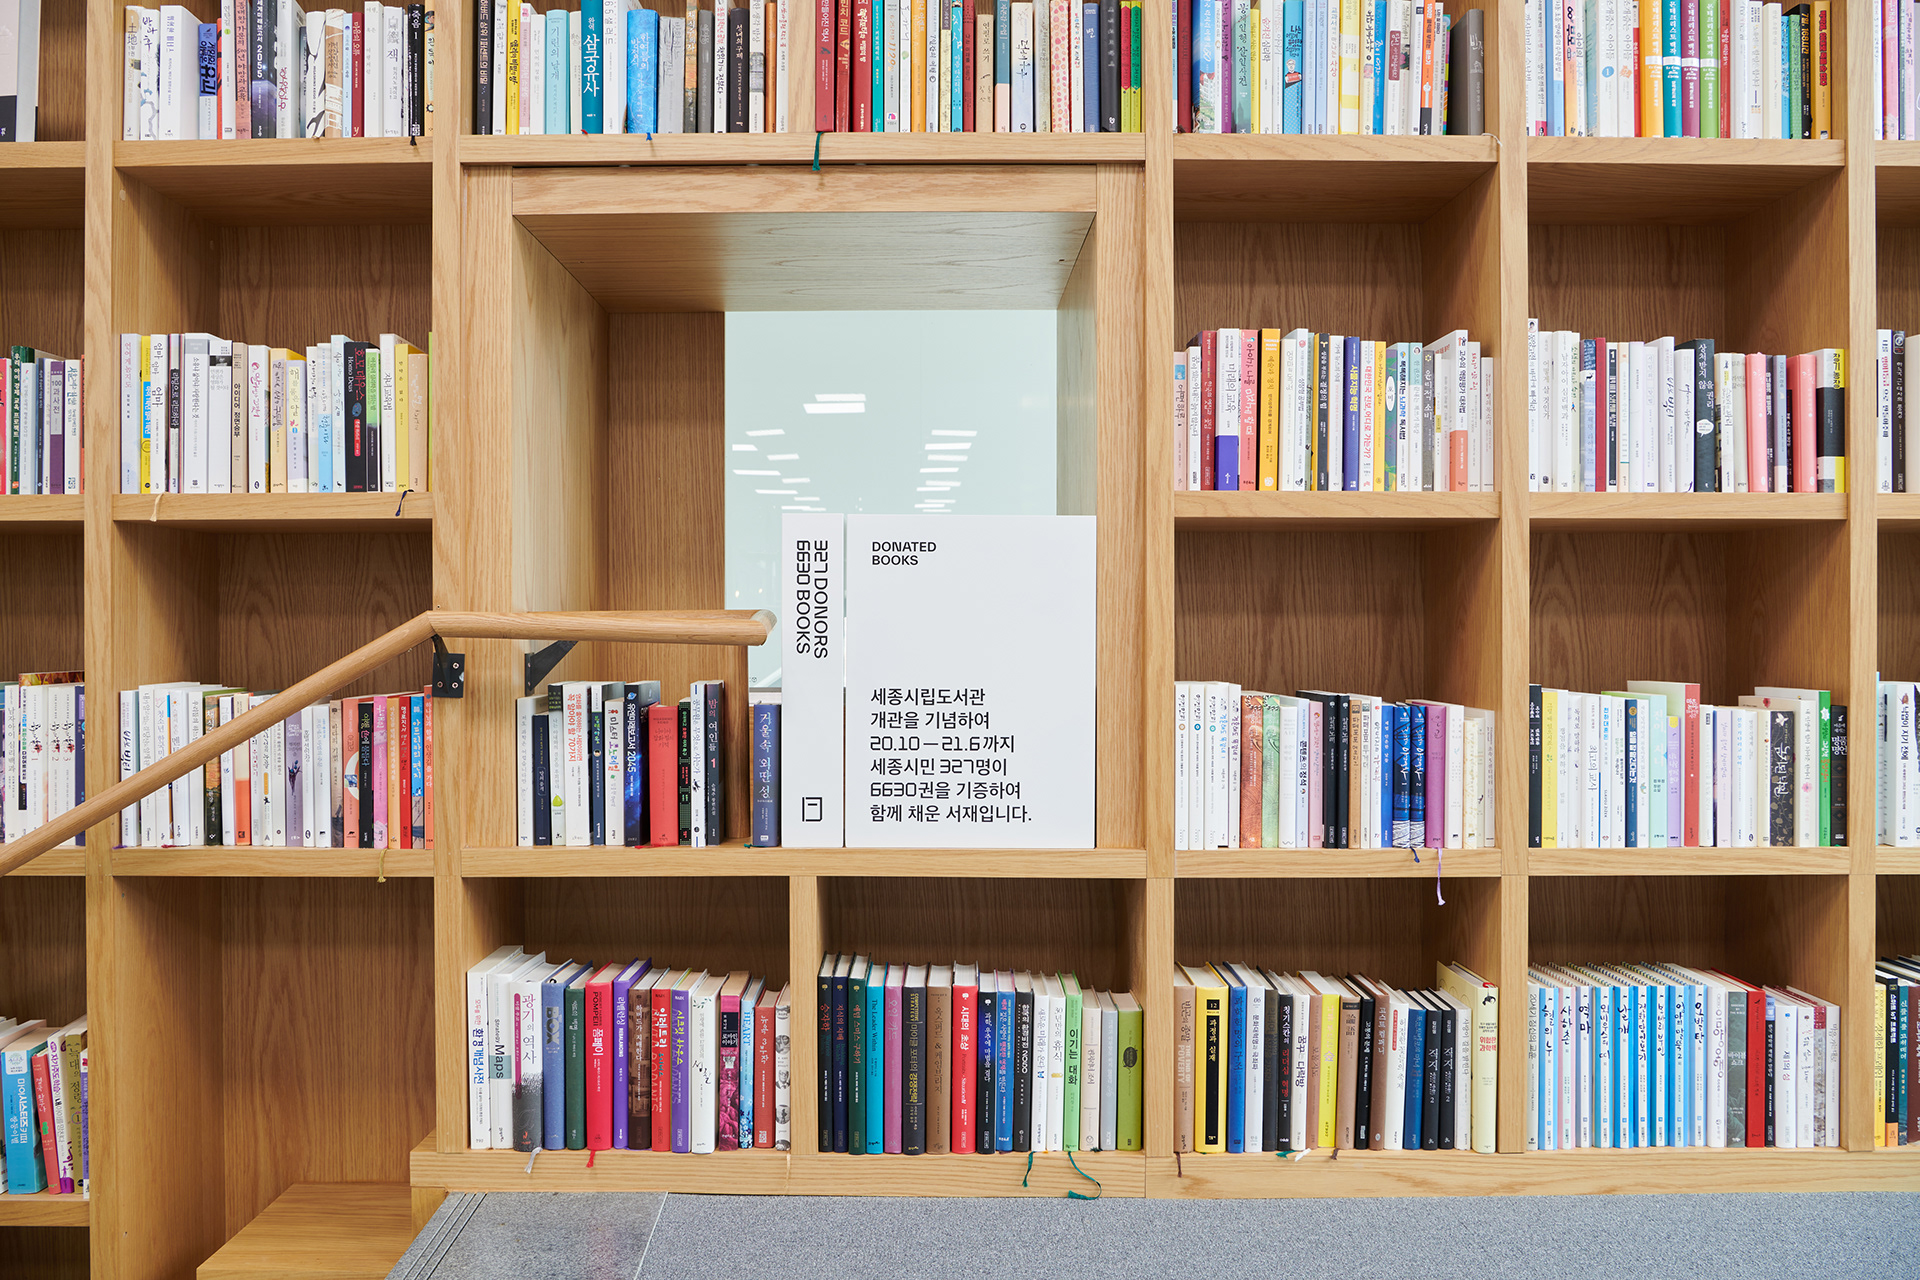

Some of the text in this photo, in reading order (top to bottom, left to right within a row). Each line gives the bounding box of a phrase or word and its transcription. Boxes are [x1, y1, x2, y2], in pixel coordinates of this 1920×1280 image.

[479, 21, 489, 37] 상위
[1262, 17, 1271, 63] 숨겨진 심리학
[1576, 32, 1584, 58] 아이의
[583, 33, 600, 98] 삼국유사
[154, 342, 164, 359] 엄마
[1244, 343, 1255, 368] 아이가
[354, 347, 366, 401] 호모 데우스
[1225, 363, 1237, 413] 미래의 교육
[1244, 370, 1255, 386] 나를
[1363, 365, 1372, 393] 대한민국
[1458, 350, 1466, 414] 고수의 역량평가 대처법
[152, 386, 164, 408] 엄마
[171, 372, 180, 427] 리딩으로 리드하라
[383, 372, 393, 411] 자녀 교육법
[1174, 384, 1185, 419] 어떤 하루
[1243, 388, 1256, 415] 미치게
[1319, 381, 1328, 401] 결정의
[1349, 396, 1358, 412] 혁명
[1244, 416, 1255, 425] 할
[1399, 396, 1407, 418] 뇌과학
[1363, 433, 1372, 459] 가는가?
[871, 541, 937, 552] DONATED
[871, 555, 919, 566] BOOKS
[796, 540, 811, 654] 6630 BOOKS
[814, 540, 828, 659] 327 DONORS
[870, 688, 986, 706] 세종시립도서관
[567, 693, 576, 762] 꼭 알아야 할 70가지
[870, 711, 990, 730] 개관을 기념하여
[1901, 705, 1909, 761] 낙엽이 지기 전에
[607, 716, 620, 772] 미스터 모노레일
[627, 703, 637, 773] 유엔미래보고서 2045
[759, 757, 772, 783] 외딴
[870, 758, 1008, 776] 세종시민 327명이
[1587, 744, 1598, 791] 최고의 교사
[1773, 742, 1791, 798] 금지된 낙원
[759, 785, 771, 799] 성
[870, 781, 1021, 799] 6630권을 기증하여
[870, 804, 1032, 823] 함께 채운 서재입니다.
[474, 1014, 481, 1026] 위한
[546, 1006, 560, 1045] BOX
[616, 996, 626, 1026] 리밸런싱
[820, 1003, 831, 1031] 승자학
[836, 1003, 844, 1041] 지식의 지배
[888, 999, 898, 1041] 오일 카드
[1180, 1000, 1191, 1042] 빈곤의 종말
[1578, 1003, 1592, 1035] 역마
[521, 993, 537, 1064] 광기의 역사
[592, 1028, 604, 1056] 폼페이
[654, 1007, 668, 1048] 일렉트릭
[674, 1010, 685, 1065] 시크릿 하우스
[742, 1011, 751, 1046] HEART
[853, 1020, 861, 1041] 스미스
[960, 1006, 969, 1050] 시대의 초상
[1037, 1008, 1046, 1069] 새로운 미래가 온다
[1251, 1014, 1260, 1050] 문화대혁명과
[1462, 1018, 1470, 1039] 사랑이
[1528, 1018, 1536, 1043] 정신의
[494, 1019, 506, 1079] Strategy Maps
[853, 1043, 861, 1064] 구하기
[909, 1024, 919, 1103] 마이클 포터의 경쟁전략
[1067, 1028, 1078, 1086] 이기는 대화
[1178, 1044, 1186, 1083] POVERTY
[1234, 1051, 1244, 1071] 구조
[1528, 1044, 1536, 1059] 교훈
[1296, 1061, 1307, 1088] 다락방
[1783, 1050, 1791, 1081] 제1의 성
[17, 1078, 28, 1144] 마이시스터즈키퍼
[9, 1115, 19, 1145] 쌍둥이별
